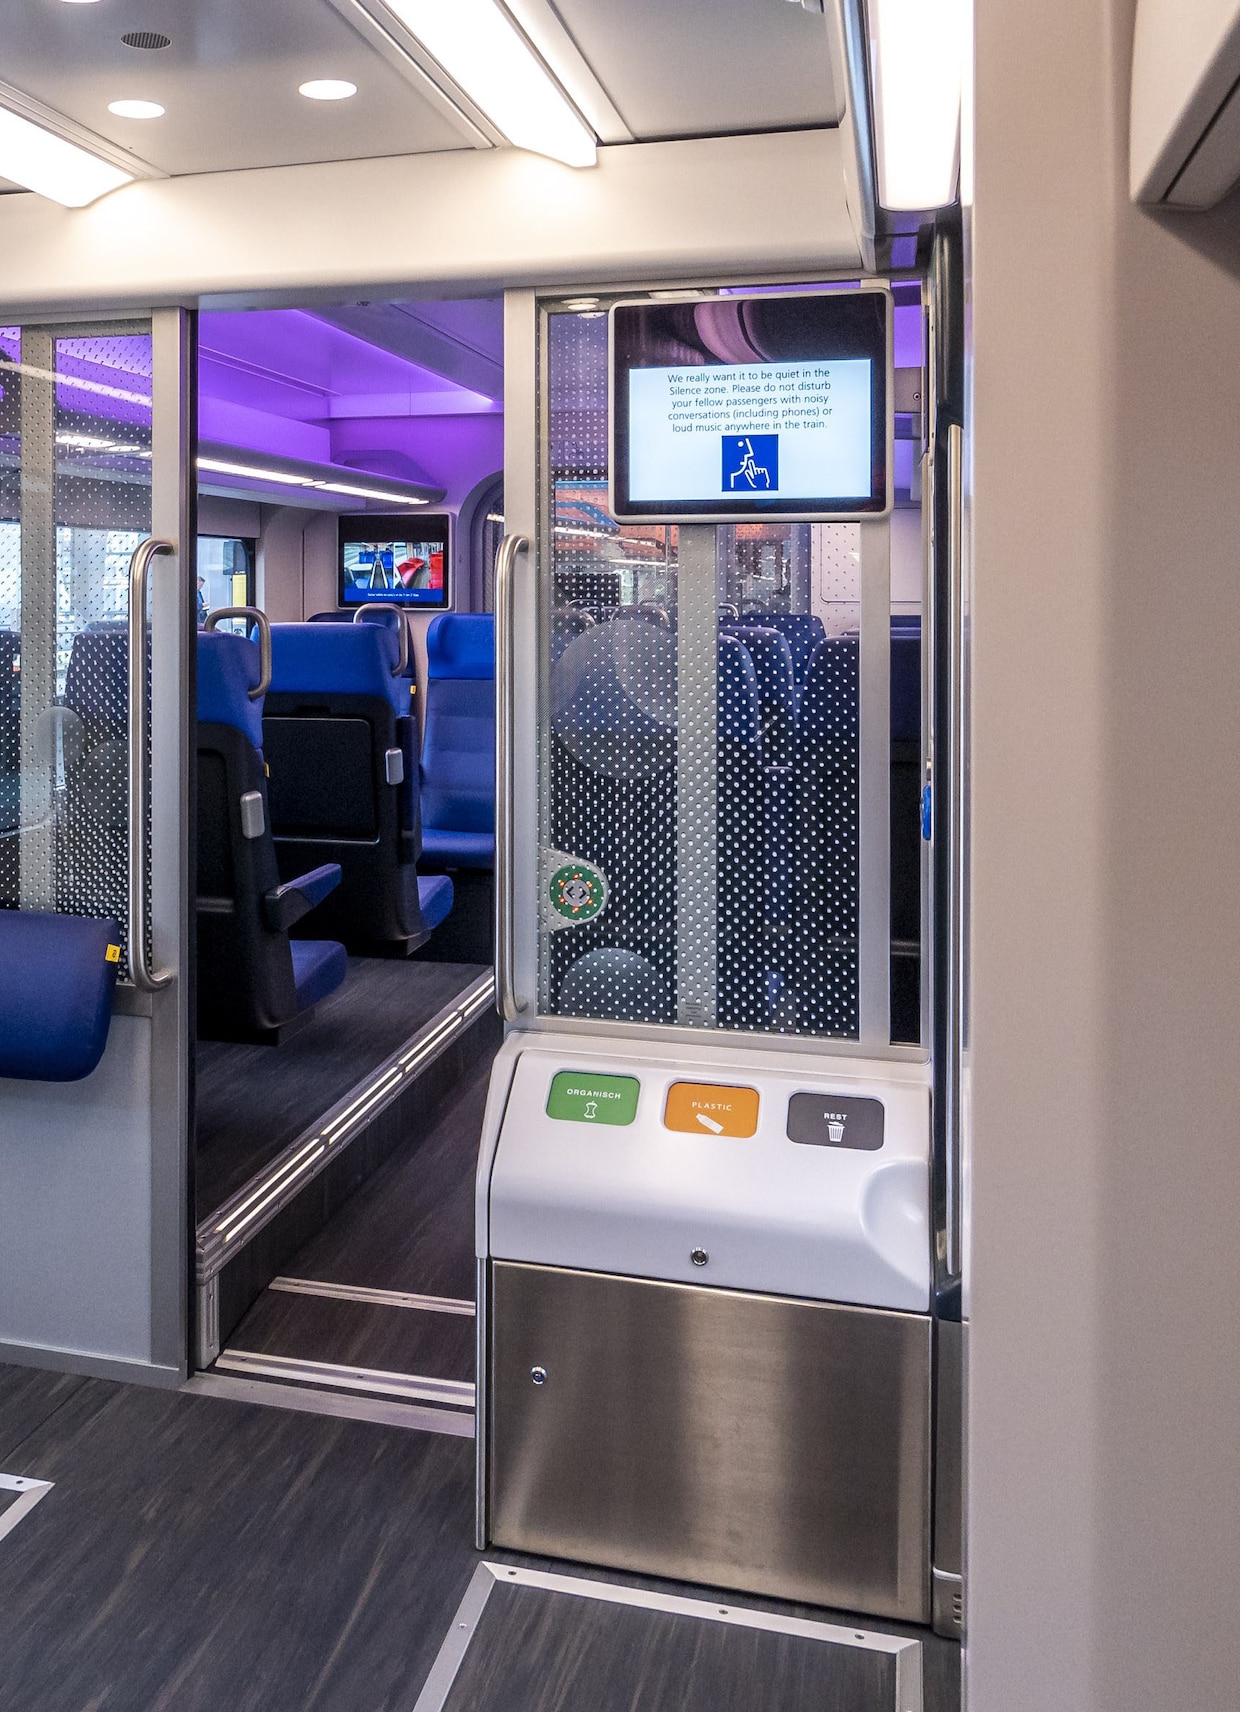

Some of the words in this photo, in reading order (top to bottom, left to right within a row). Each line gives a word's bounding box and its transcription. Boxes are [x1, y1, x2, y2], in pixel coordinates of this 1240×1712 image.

[668, 375, 682, 383] We
[686, 373, 710, 383] really
[739, 372, 745, 380] it
[749, 372, 757, 380] to
[761, 371, 772, 379] be
[776, 370, 799, 380] quiet
[803, 369, 810, 377] in
[814, 368, 829, 377] the
[670, 386, 701, 395] Silence
[704, 386, 728, 394] zone.
[733, 384, 760, 393] Please
[764, 383, 775, 392] do
[779, 383, 794, 391] not
[798, 381, 831, 390] disturb
[672, 400, 691, 409] your
[695, 398, 723, 407] fellow
[726, 397, 777, 407] passengers
[780, 396, 800, 404] with
[805, 395, 828, 405] noisy
[668, 410, 730, 420] conversations
[733, 408, 778, 419] (including
[782, 407, 819, 417] phones)
[673, 424, 692, 432] loud
[696, 423, 721, 431] music
[725, 421, 769, 432] anywhere
[773, 421, 781, 430] in
[785, 420, 800, 429] the
[566, 1088, 621, 1100] ORGANISCH
[691, 1101, 733, 1112] PLASTIC
[823, 1112, 848, 1121] REST
